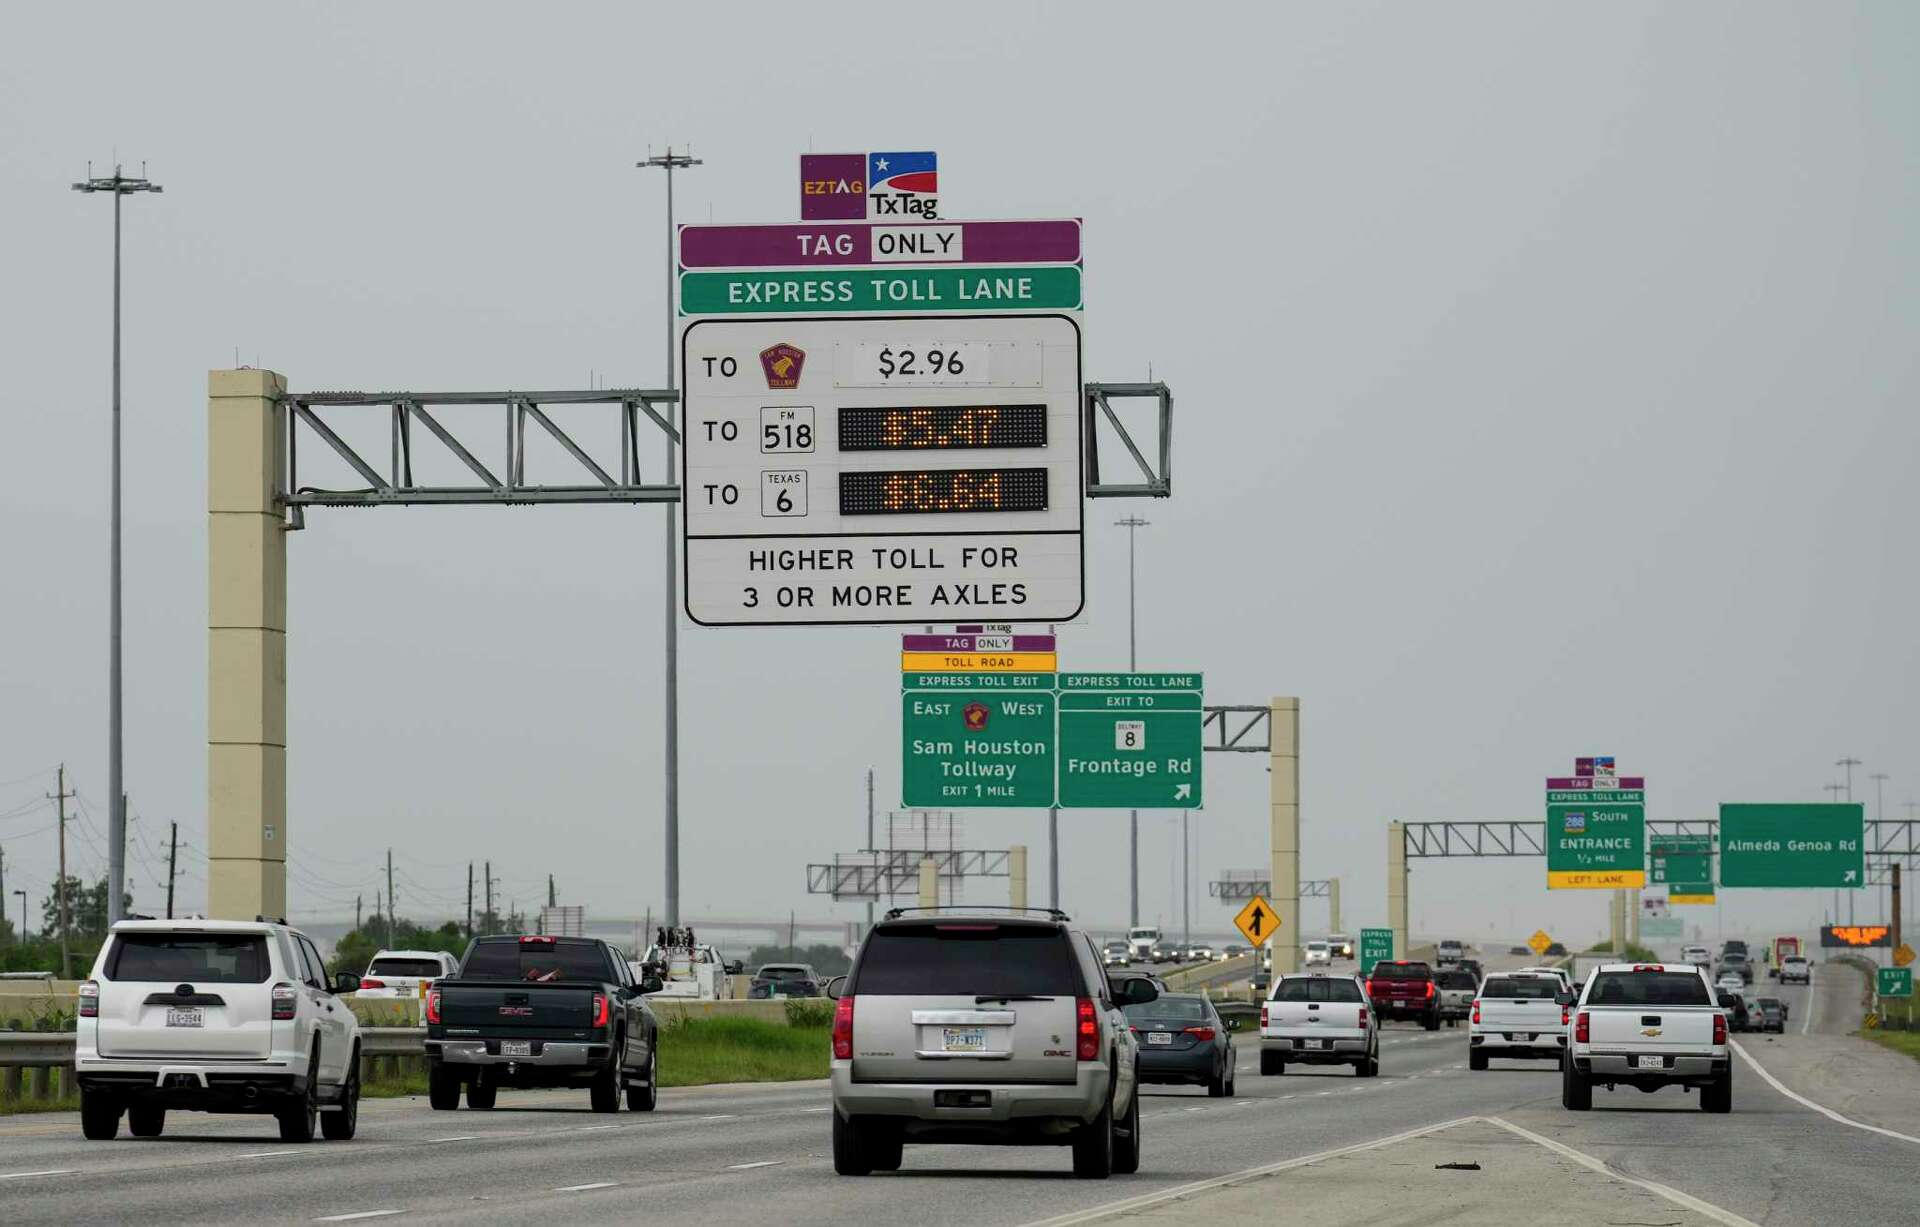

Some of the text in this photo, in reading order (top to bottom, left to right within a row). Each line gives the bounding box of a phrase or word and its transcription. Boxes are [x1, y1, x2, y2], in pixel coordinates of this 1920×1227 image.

[804, 178, 864, 194] EZTAG
[869, 193, 938, 220] TxTag
[797, 232, 955, 256] TAG ONLY
[728, 277, 1033, 304] EXPRESS TOLL LANE
[702, 356, 738, 378] TO
[878, 348, 965, 379] $2.96
[780, 411, 796, 421] FM
[882, 408, 999, 447] $5.47
[703, 420, 813, 450] TO 518
[767, 473, 801, 484] TEXAS
[883, 472, 1001, 510] $6.64
[703, 484, 793, 513] TO 6
[749, 546, 1020, 571] HIGHER TOLL FOR
[743, 583, 1028, 608] 3 OR MORE AXLES
[945, 638, 1011, 649] TAG ONLY
[944, 657, 1015, 667] TOLL ROAD
[918, 676, 1040, 687] EXPRESS TOLL EXIT
[1067, 676, 1193, 687] EXPRESS TOLL LANE
[913, 701, 952, 716] EAST
[1001, 701, 1044, 716] WEST
[1106, 696, 1155, 707] EXIT TO
[1125, 731, 1136, 747] 8
[912, 740, 1046, 755] Sam Houston
[941, 761, 1017, 781] Tollway
[1068, 758, 1192, 777] Frontage Rd
[942, 784, 1016, 798] EXIT 1 MILE
[1571, 780, 1617, 788] TAG ONLY
[1550, 793, 1640, 801] EXPRESS TOLL LANE
[1592, 811, 1629, 821] SOUTH
[1560, 837, 1632, 850] ENTRANCE
[1728, 838, 1857, 852] Almeda Genoa Rd
[1595, 854, 1616, 863] MILE
[1567, 875, 1624, 884] LEFT LANE
[1365, 949, 1388, 958] EXIT
[1884, 970, 1906, 980] EXIT
